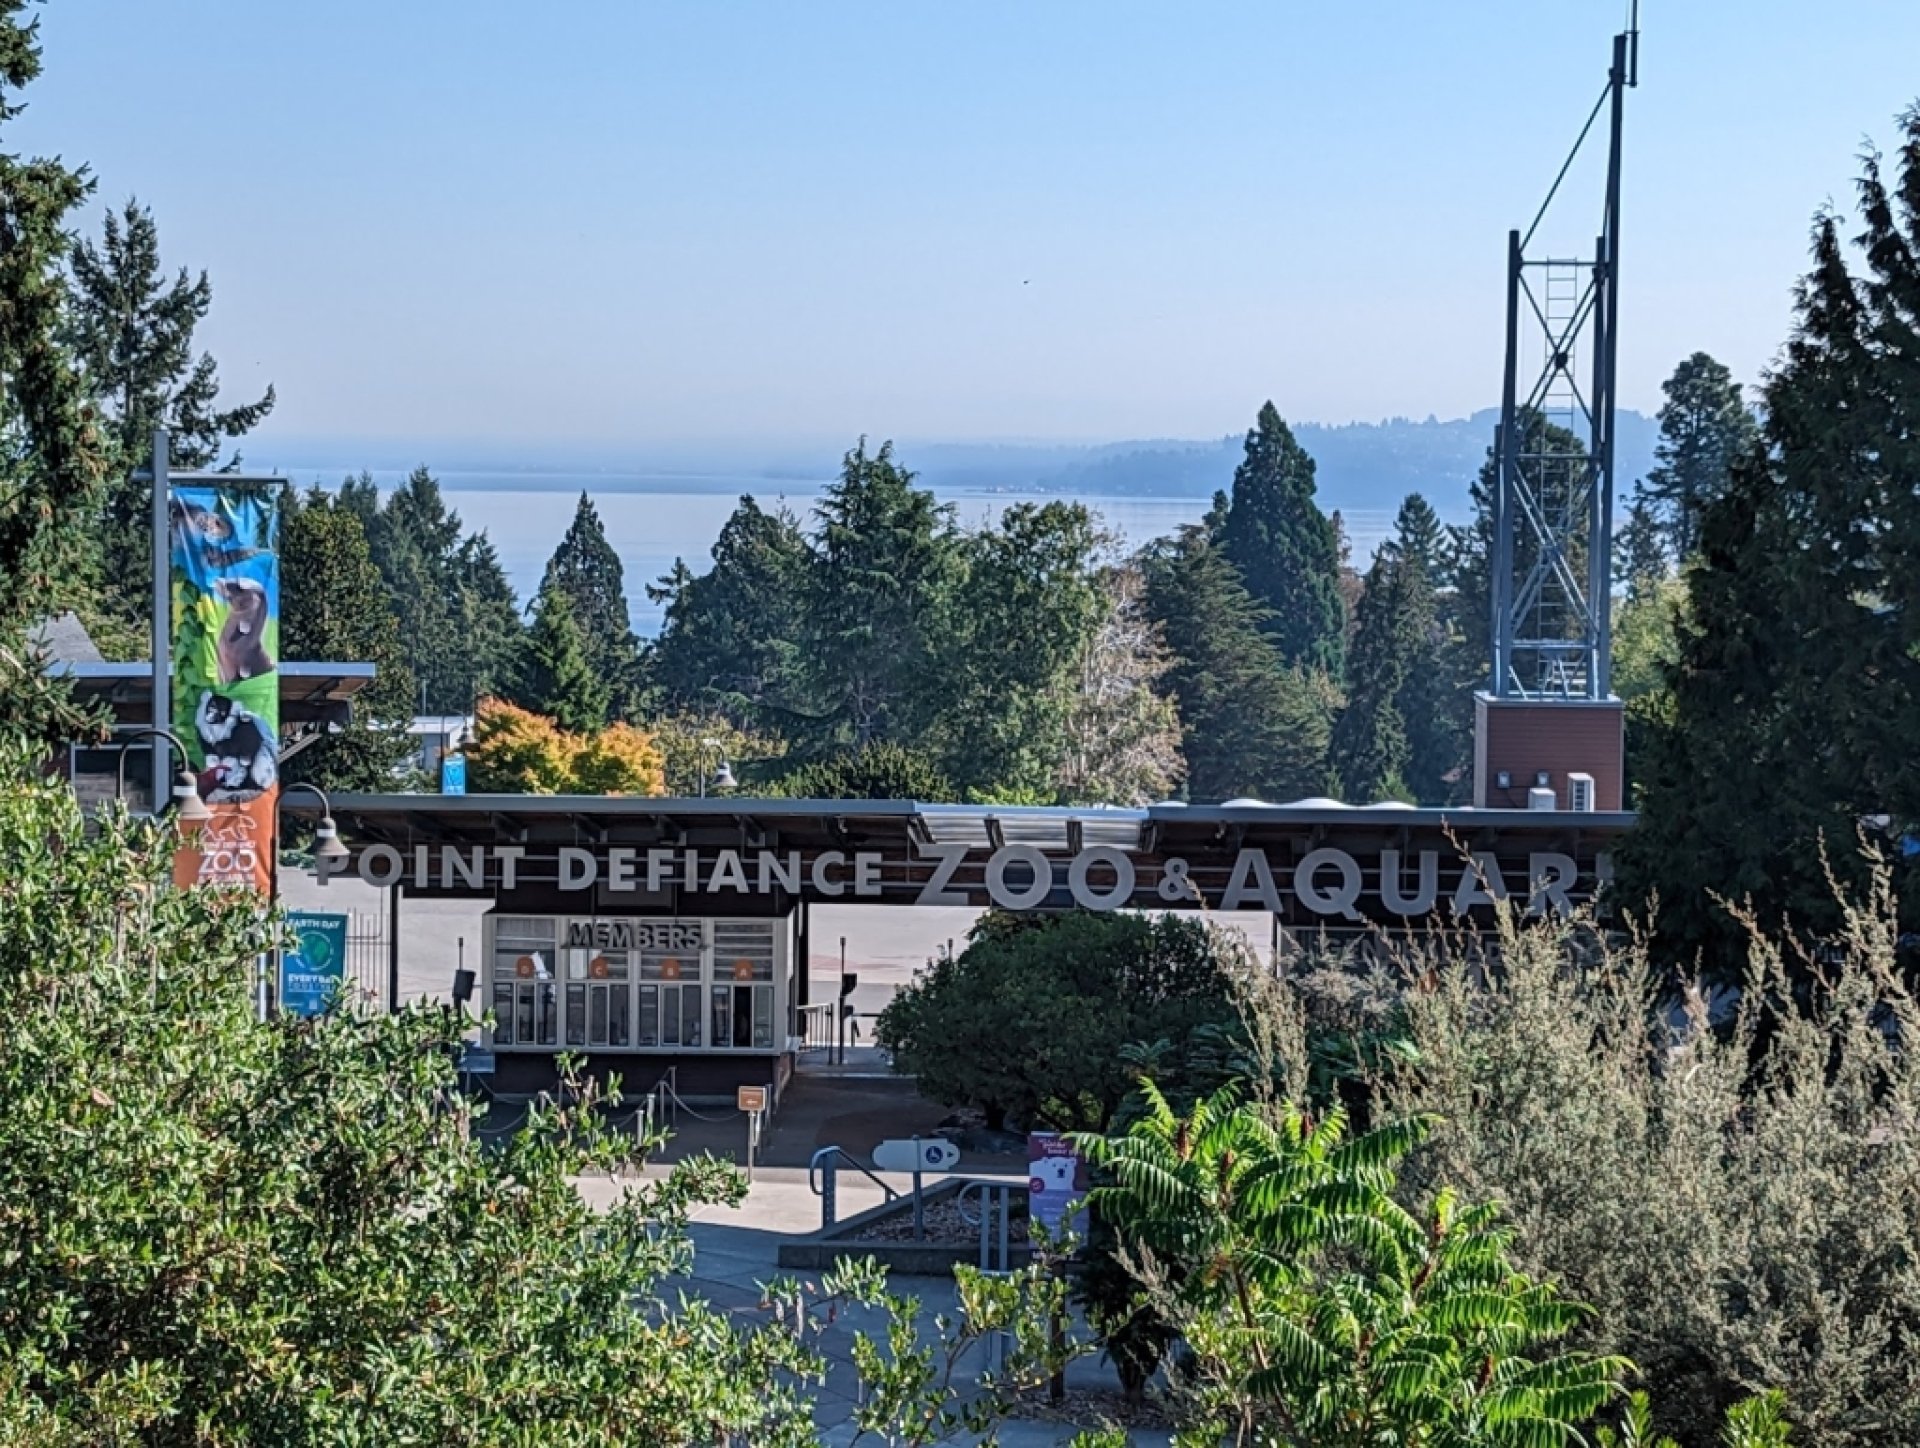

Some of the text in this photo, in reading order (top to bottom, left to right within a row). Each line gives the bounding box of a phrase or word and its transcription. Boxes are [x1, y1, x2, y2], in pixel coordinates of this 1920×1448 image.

[198, 849, 256, 873] ZOO
[316, 843, 525, 889] POINT
[557, 847, 883, 896] DEFIANCE
[915, 843, 1136, 911] ZOO
[1157, 857, 1197, 902] &
[568, 922, 702, 951] MEMBERS
